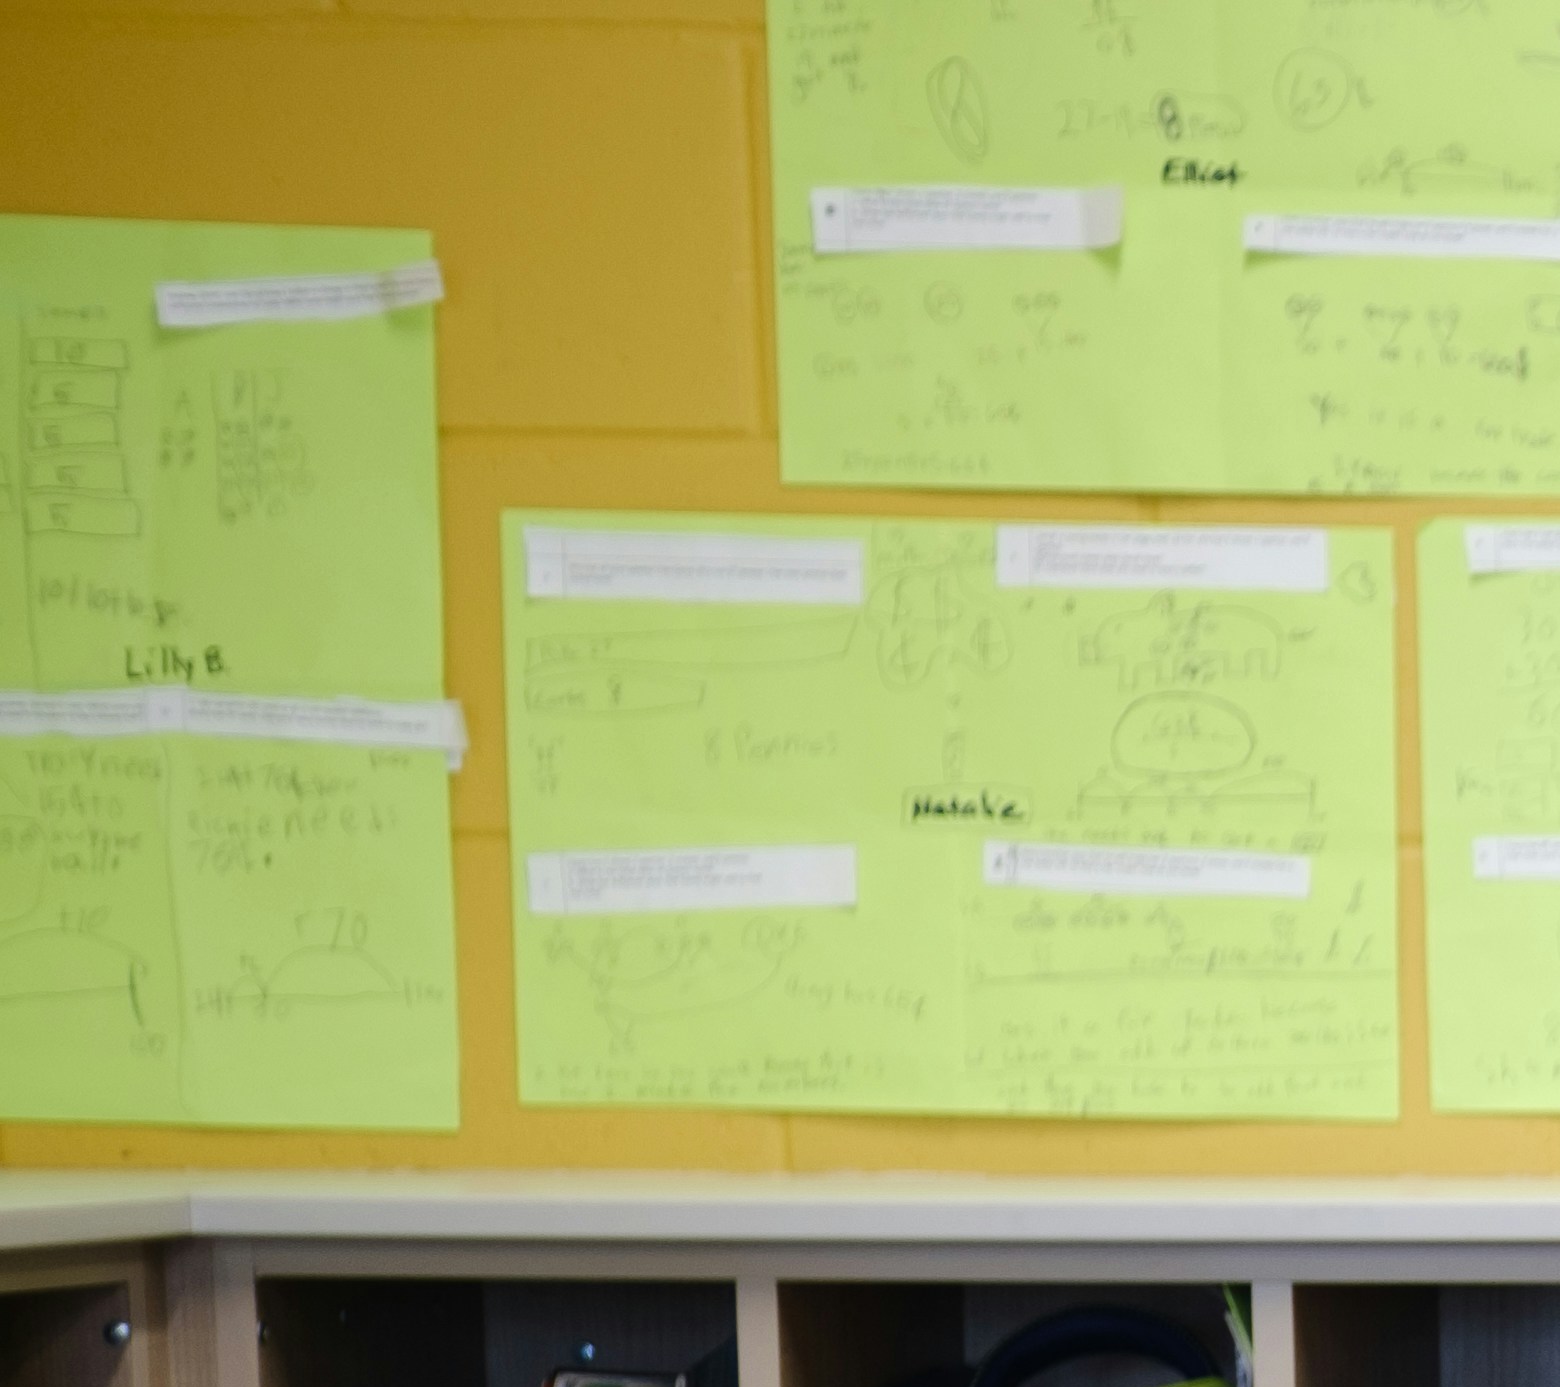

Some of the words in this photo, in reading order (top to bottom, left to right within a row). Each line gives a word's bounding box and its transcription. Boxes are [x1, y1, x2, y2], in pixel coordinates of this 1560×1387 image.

[1161, 158, 1240, 187] Elliot
[126, 646, 193, 682] Lilly
[912, 790, 1024, 820] Natalie
